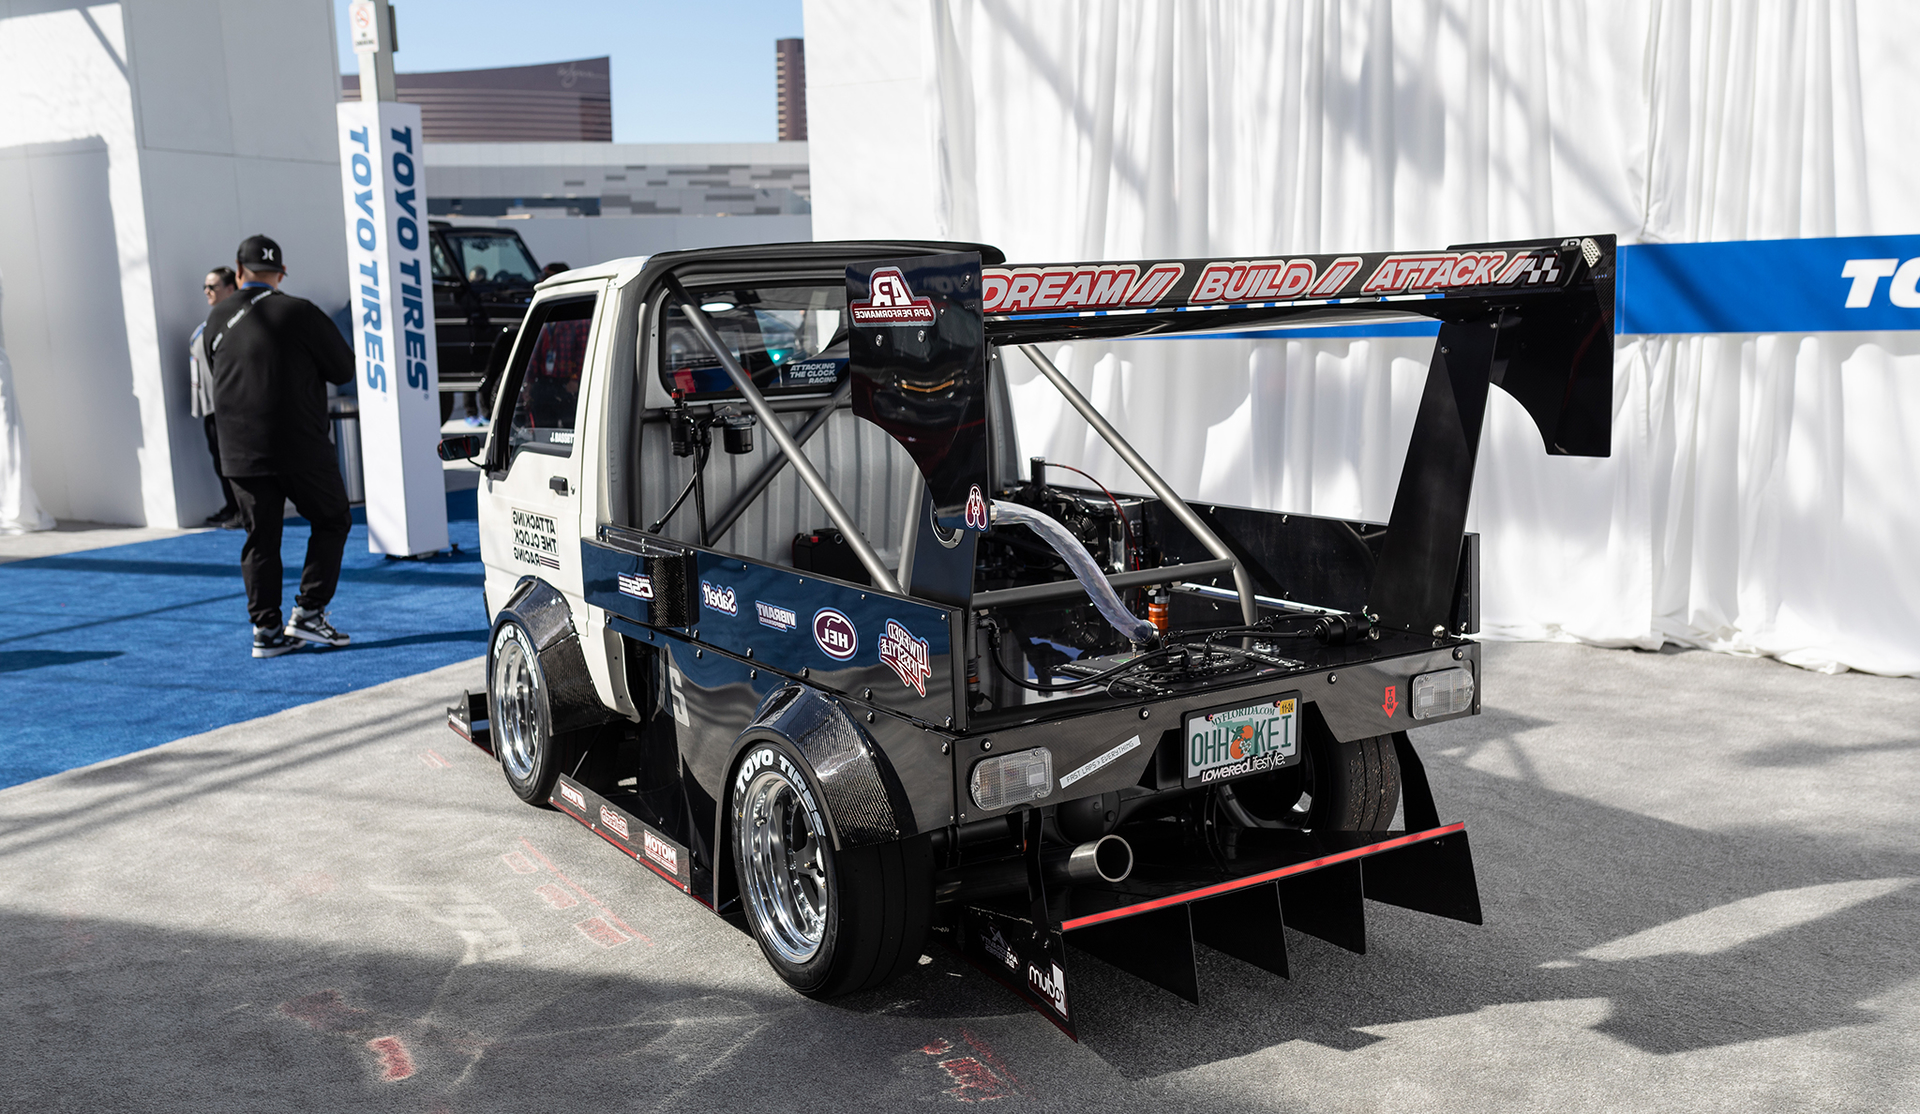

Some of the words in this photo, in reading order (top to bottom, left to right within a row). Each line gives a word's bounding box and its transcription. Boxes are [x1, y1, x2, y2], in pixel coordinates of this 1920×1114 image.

[350, 125, 375, 252] TOYO
[391, 125, 420, 252] TOYO
[359, 260, 388, 394] TIRES
[400, 258, 429, 391] TIRES
[790, 362, 836, 372] ATTACKING
[790, 371, 806, 379] THE
[807, 369, 836, 378] CLOCK
[808, 376, 838, 384] RACING
[1211, 706, 1276, 727] MYFLORIDA.COM
[736, 748, 774, 795] TOYO
[778, 754, 827, 837] TIRES
